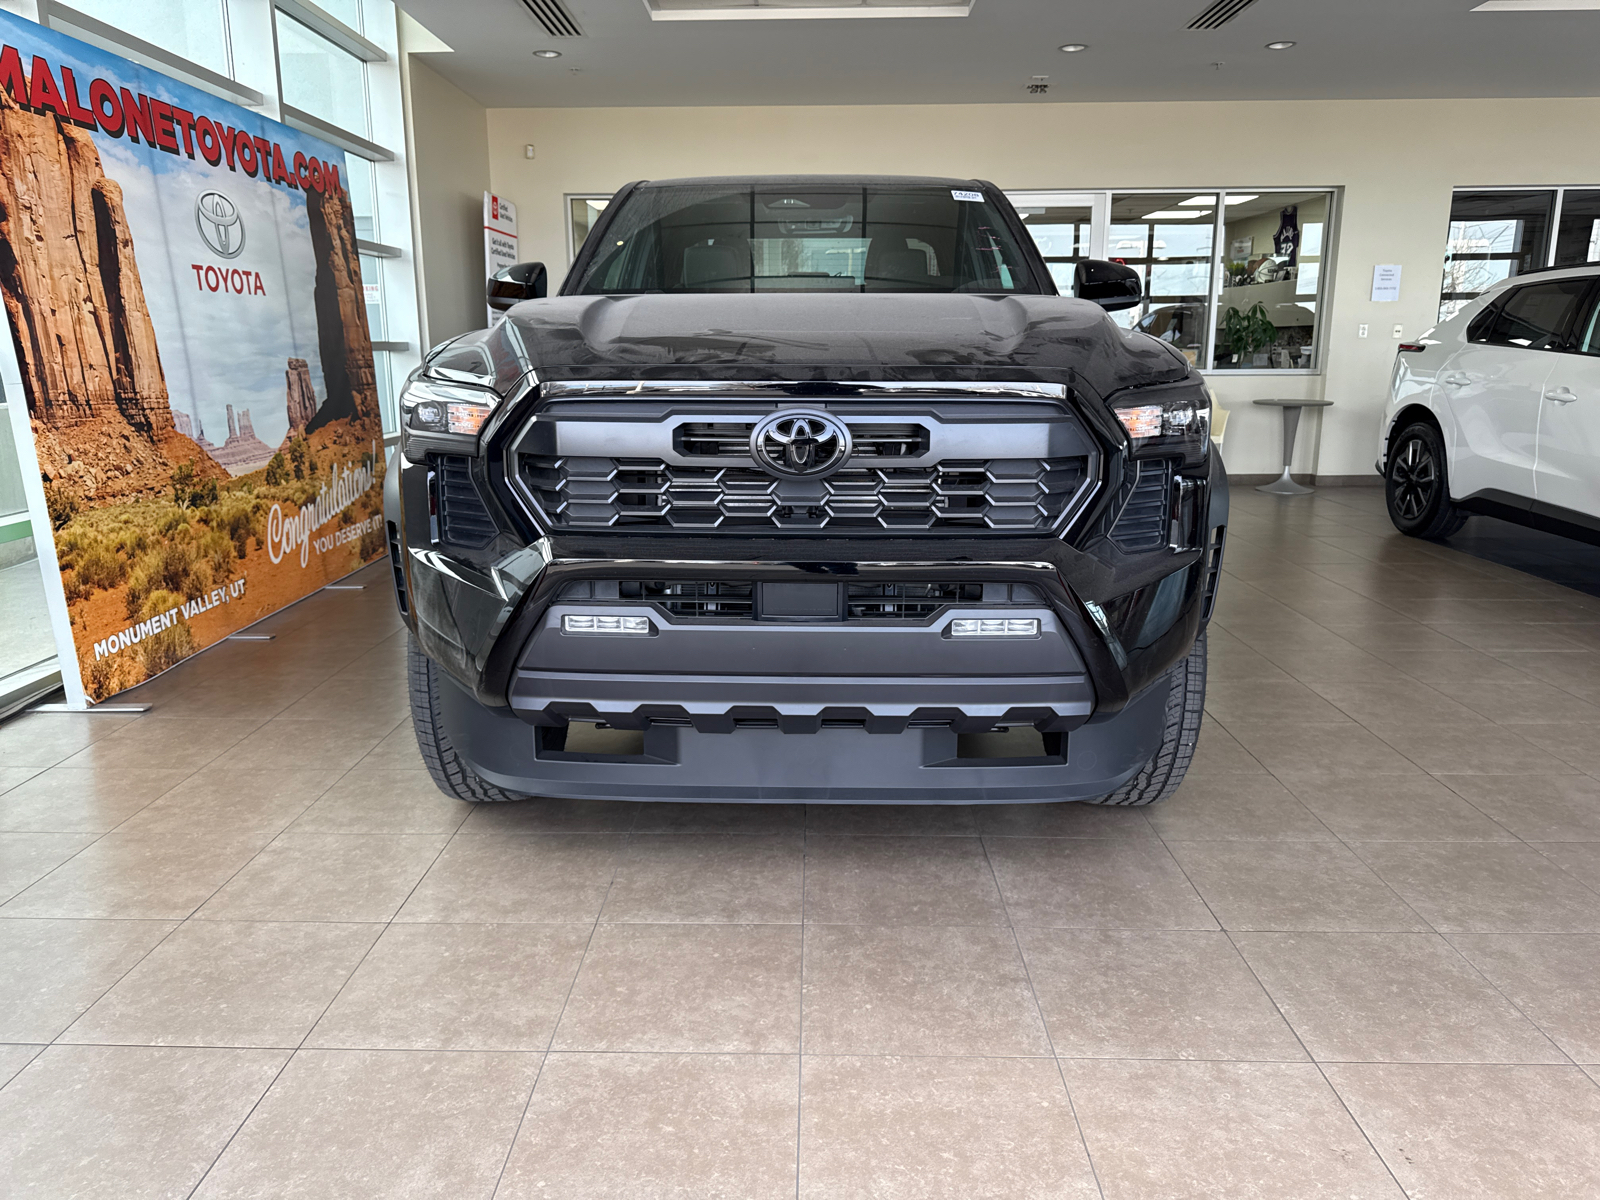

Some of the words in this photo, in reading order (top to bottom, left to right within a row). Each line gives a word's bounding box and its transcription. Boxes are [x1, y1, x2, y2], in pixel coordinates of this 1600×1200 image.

[191, 264, 267, 296] TOYOTA
[267, 439, 376, 569] Congratulations!
[313, 532, 334, 555] YOU
[335, 518, 372, 547] DESERVE
[372, 513, 383, 530] IT!
[93, 607, 179, 662] MONUMENT
[180, 585, 230, 620] VALLEY,
[229, 578, 246, 598] UT
